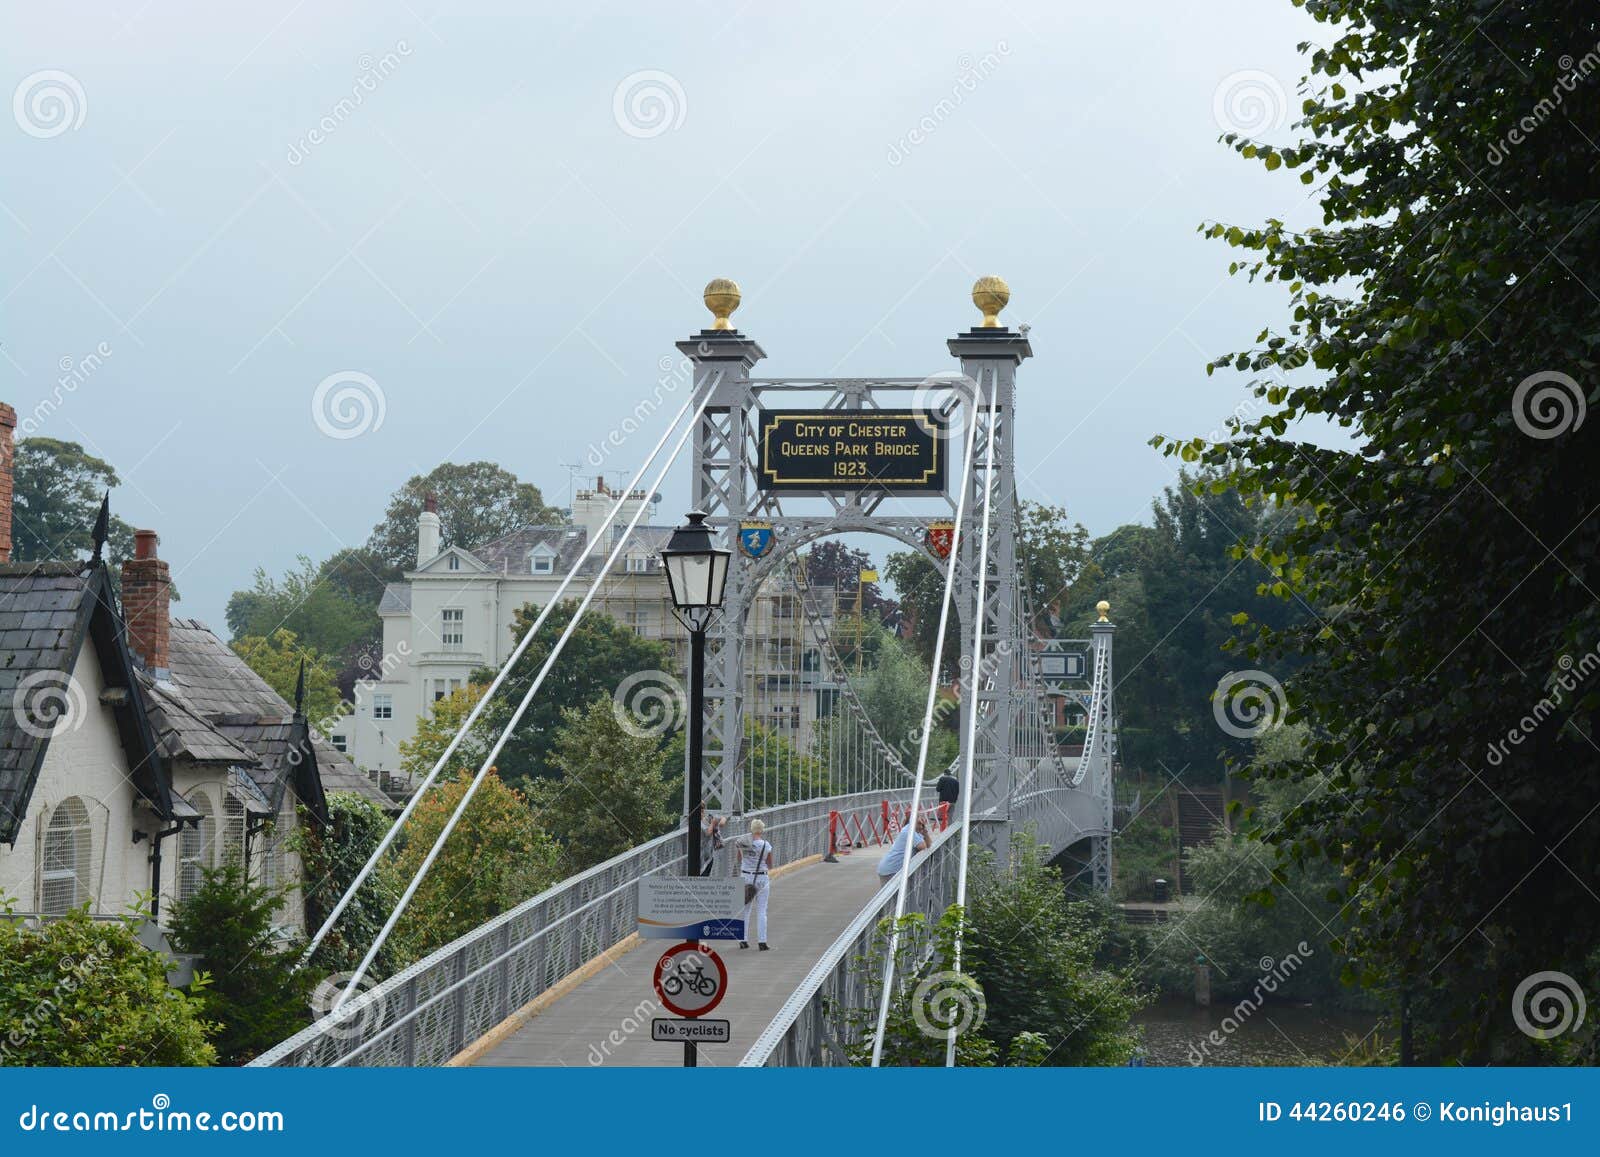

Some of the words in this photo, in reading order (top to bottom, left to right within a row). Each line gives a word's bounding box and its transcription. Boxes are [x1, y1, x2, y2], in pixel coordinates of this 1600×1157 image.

[795, 423, 825, 438] CITY
[849, 423, 907, 438] CHESTER
[781, 442, 830, 457] QUEENS
[835, 442, 869, 456] PARK
[875, 442, 920, 456] BRIDGE
[833, 462, 867, 476] 1923
[658, 1024, 676, 1035] No
[679, 1024, 724, 1036] cyclists
